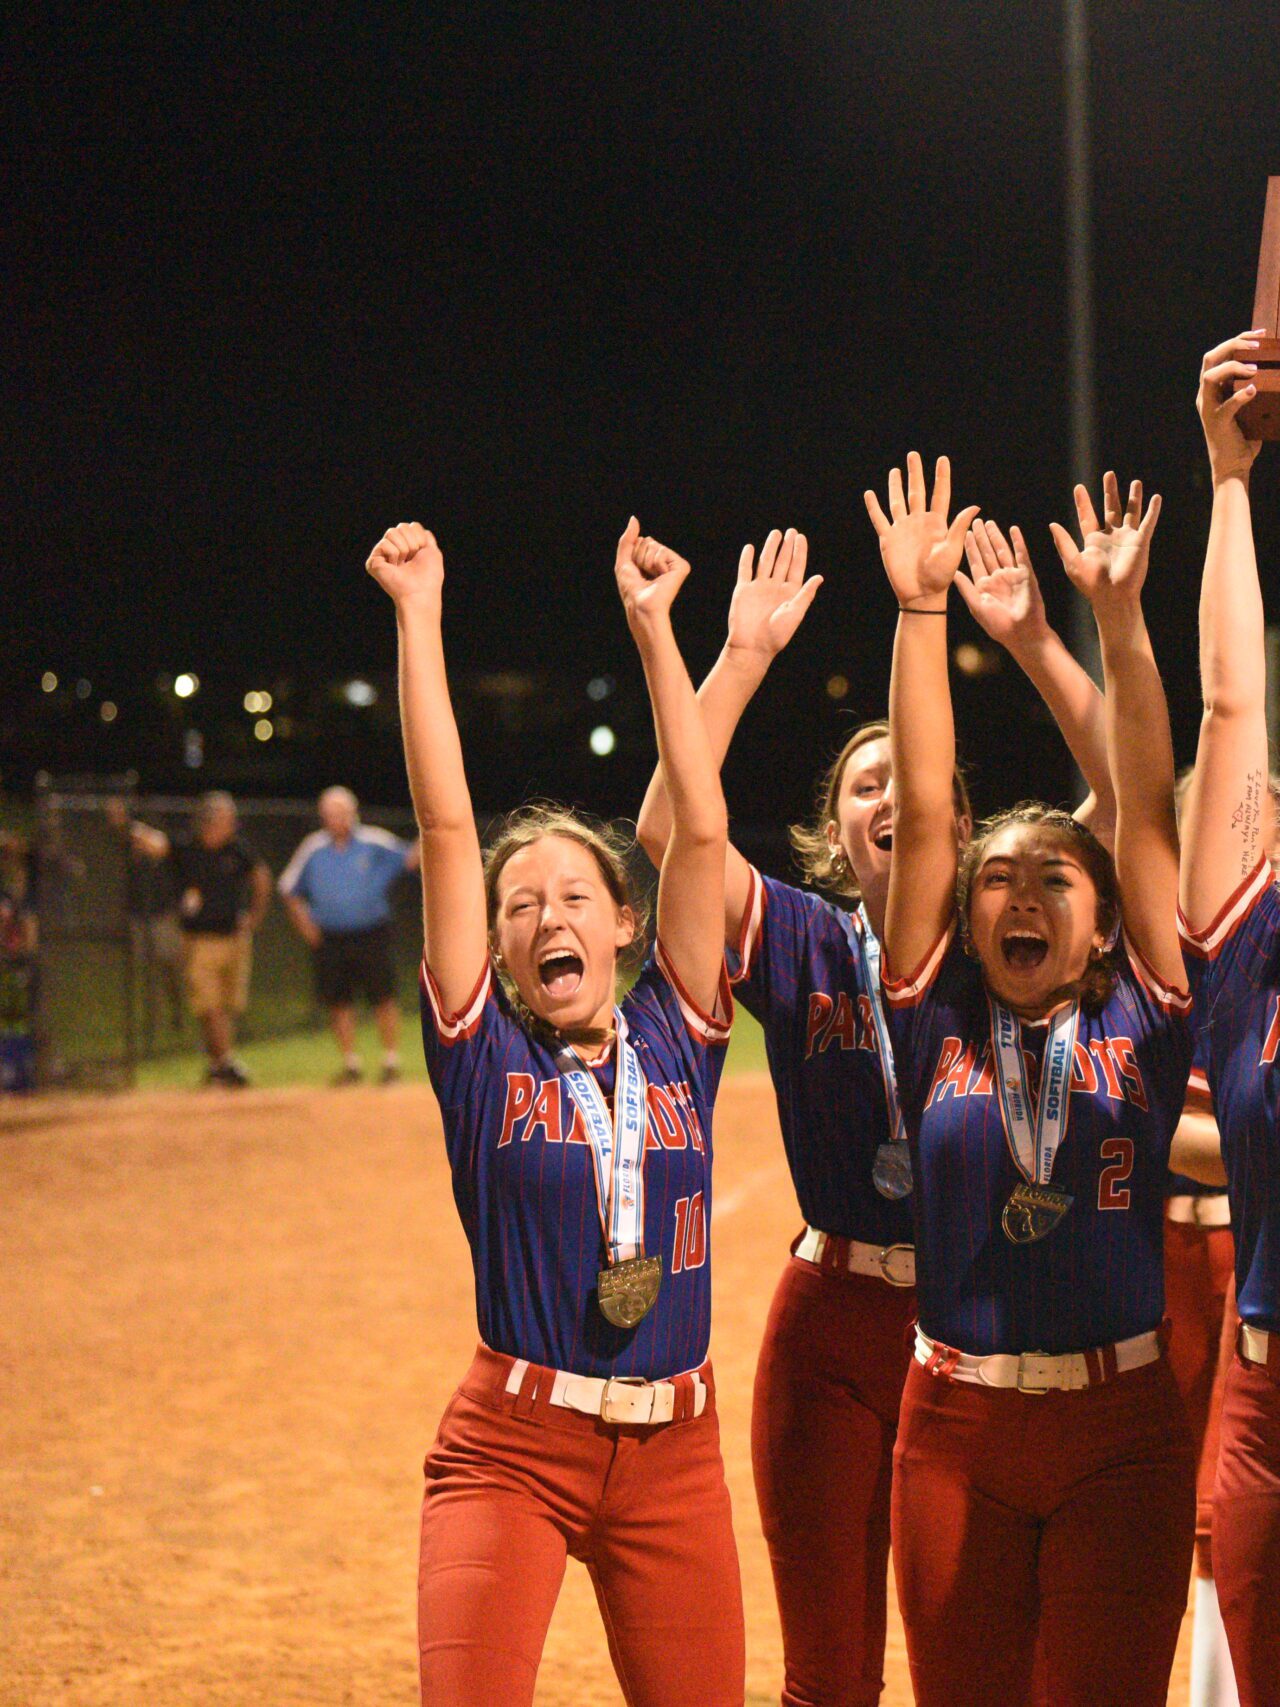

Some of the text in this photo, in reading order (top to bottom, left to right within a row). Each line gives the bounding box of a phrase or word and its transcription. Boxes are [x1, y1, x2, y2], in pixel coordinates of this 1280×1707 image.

[1000, 1009, 1013, 1049] BALL
[569, 1072, 612, 1157] SOFTBALL
[626, 1050, 638, 1132] SOFTBALL
[1046, 1039, 1067, 1121] SOFTBALL
[1044, 1146, 1053, 1182] FLORIDA
[1098, 1138, 1134, 1210] 2
[671, 1190, 707, 1274] 10
